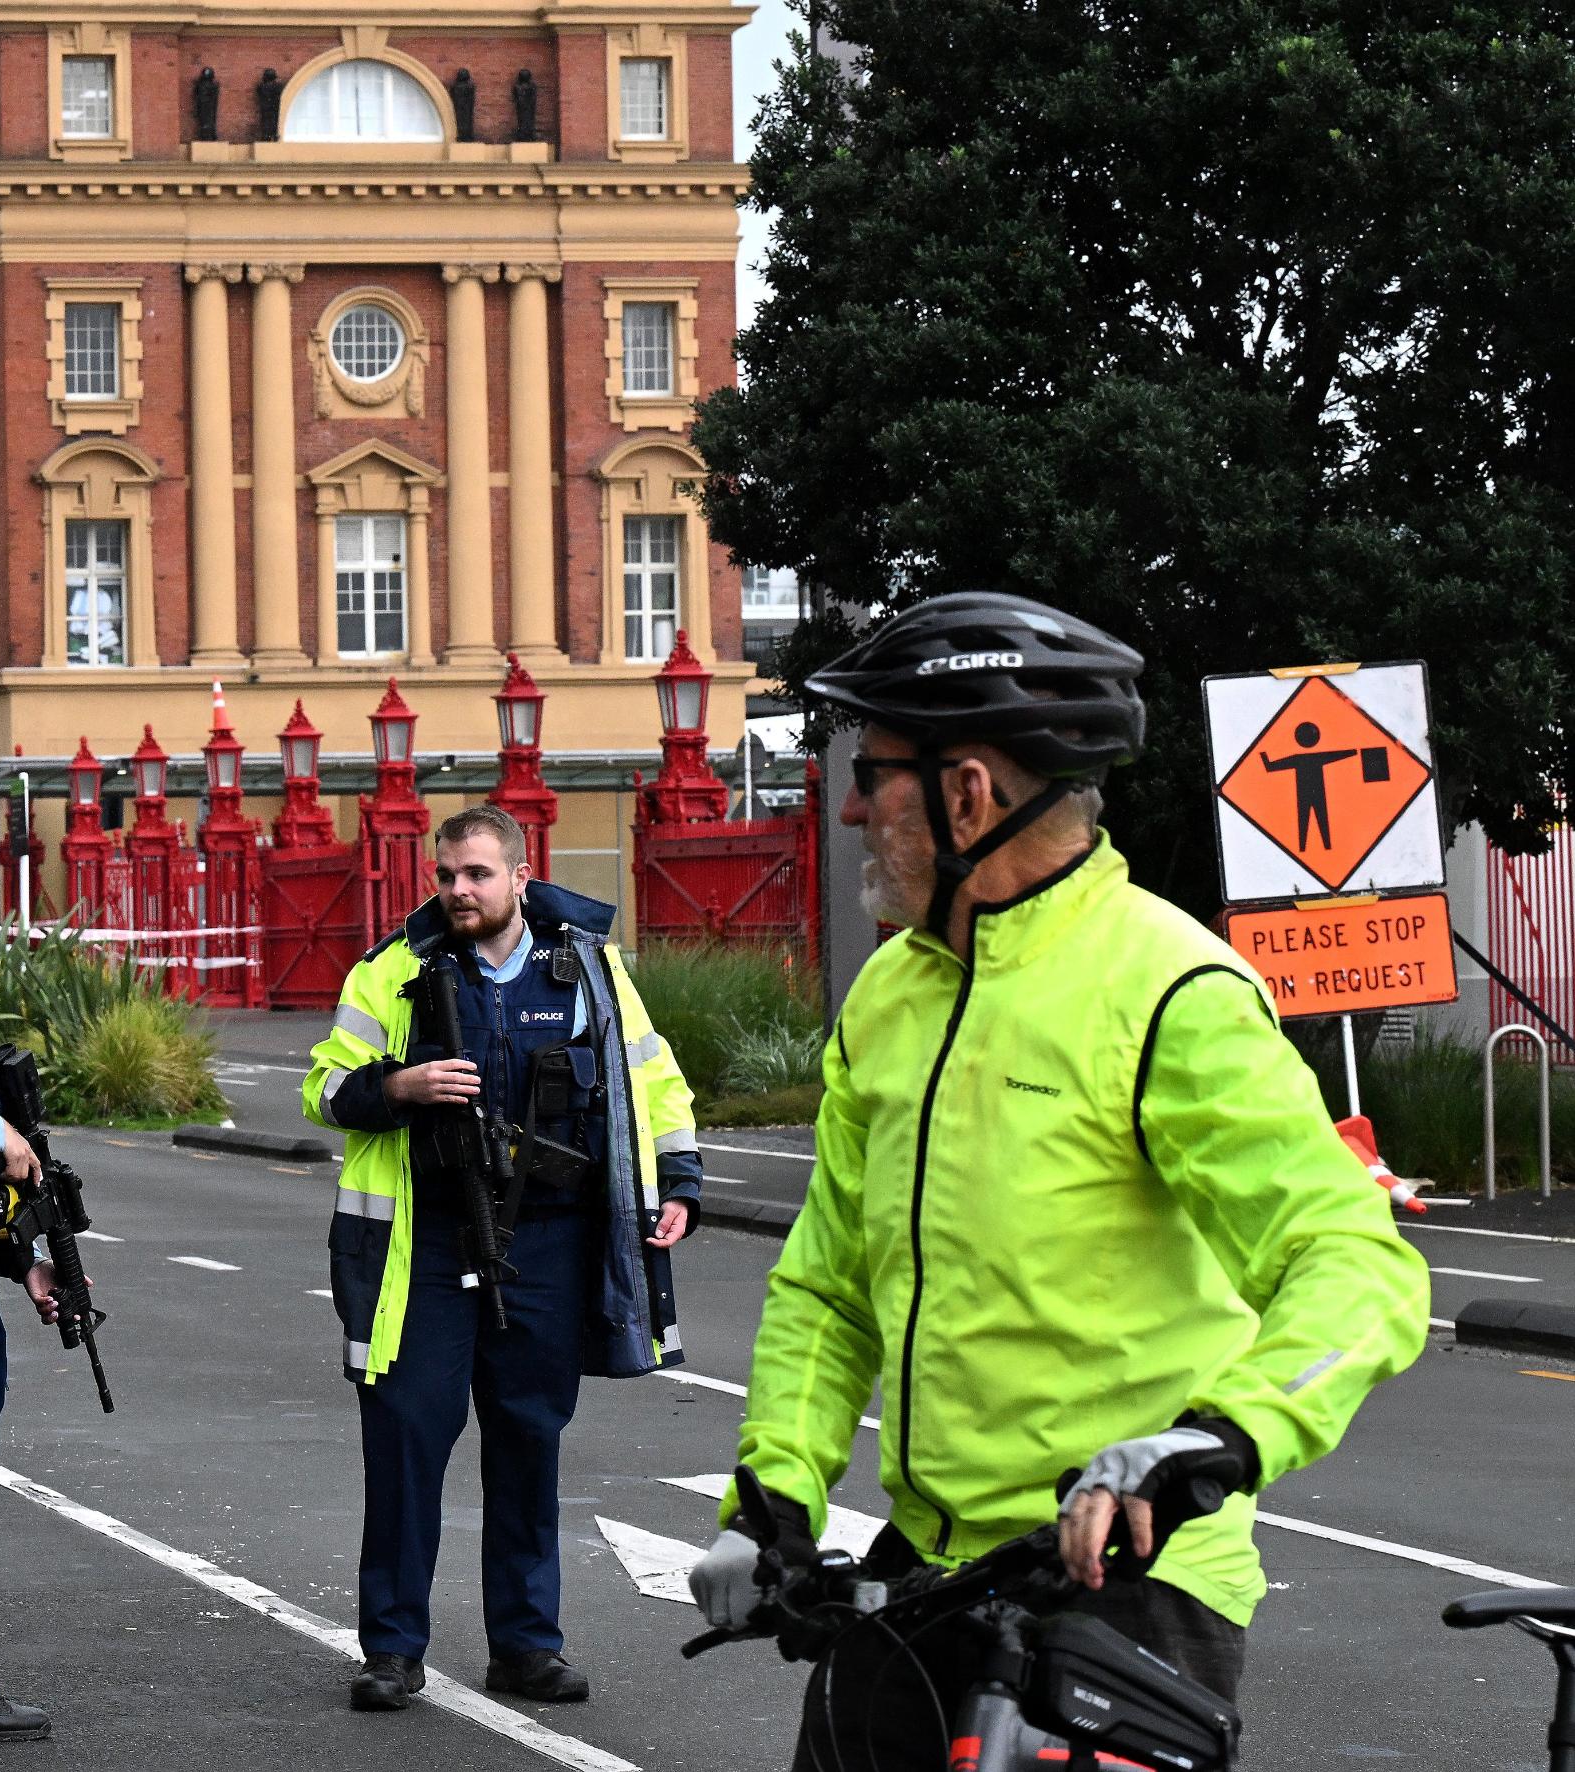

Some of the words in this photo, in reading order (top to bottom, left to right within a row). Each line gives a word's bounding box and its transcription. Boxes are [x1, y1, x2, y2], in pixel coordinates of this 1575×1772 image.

[948, 652, 1024, 670] GIRO
[1252, 923, 1348, 955] PLEASE
[1366, 915, 1426, 944] STOP
[1264, 974, 1296, 1000] ON
[1315, 961, 1426, 996] REQUEST
[534, 1012, 564, 1021] POLICE
